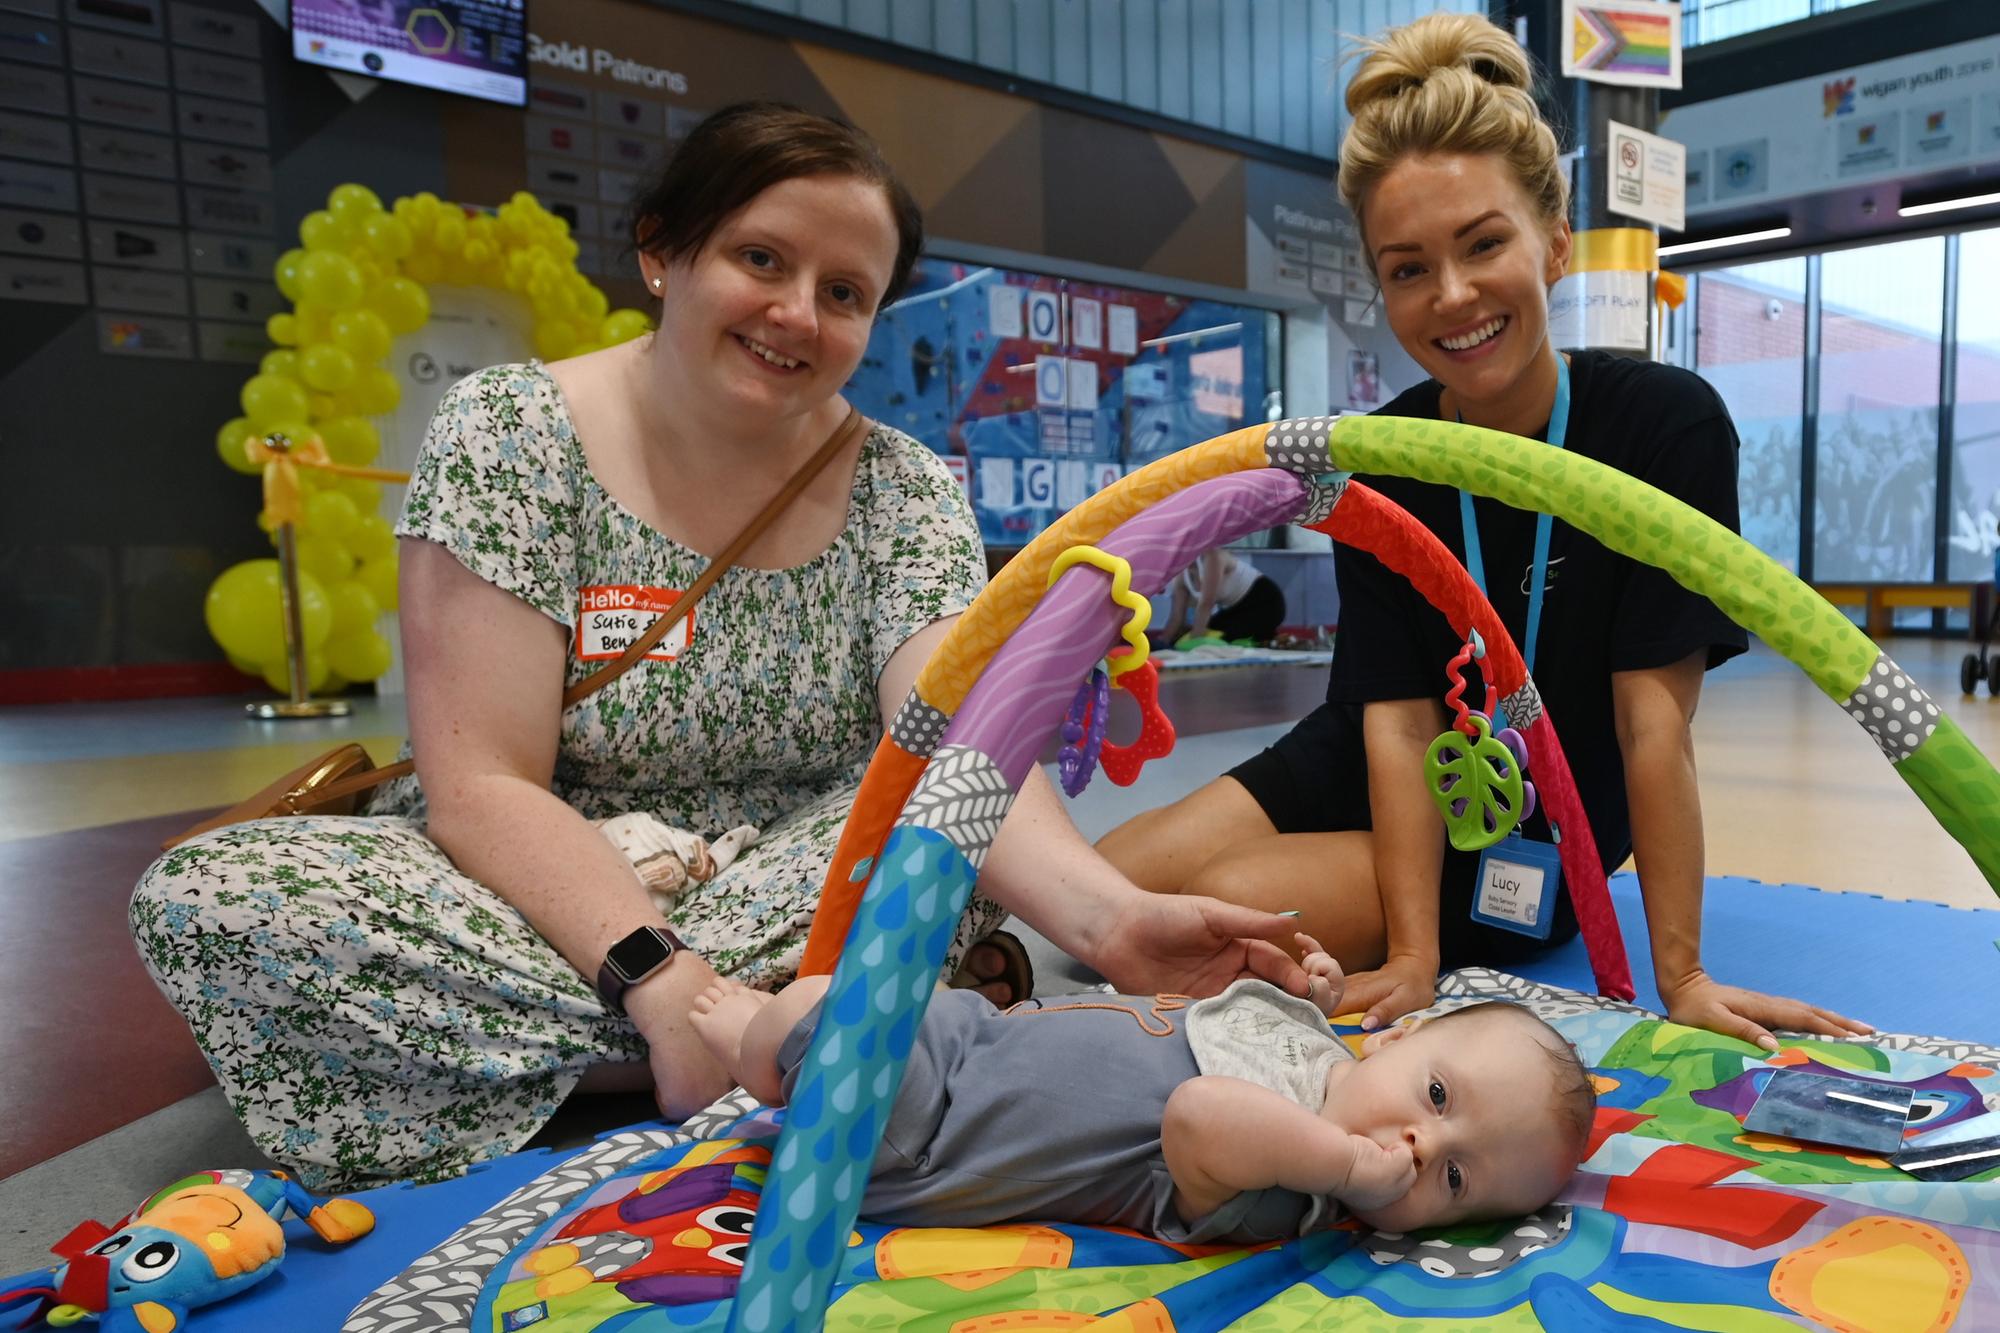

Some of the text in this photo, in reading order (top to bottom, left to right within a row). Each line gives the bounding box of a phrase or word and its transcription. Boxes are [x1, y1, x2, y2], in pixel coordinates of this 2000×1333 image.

[527, 33, 588, 71] Gold
[593, 49, 688, 94] Patrons
[1861, 77, 1907, 97] wigan
[1908, 65, 1954, 92] youth
[581, 589, 635, 609] Hello
[1492, 873, 1520, 896] Lucy
